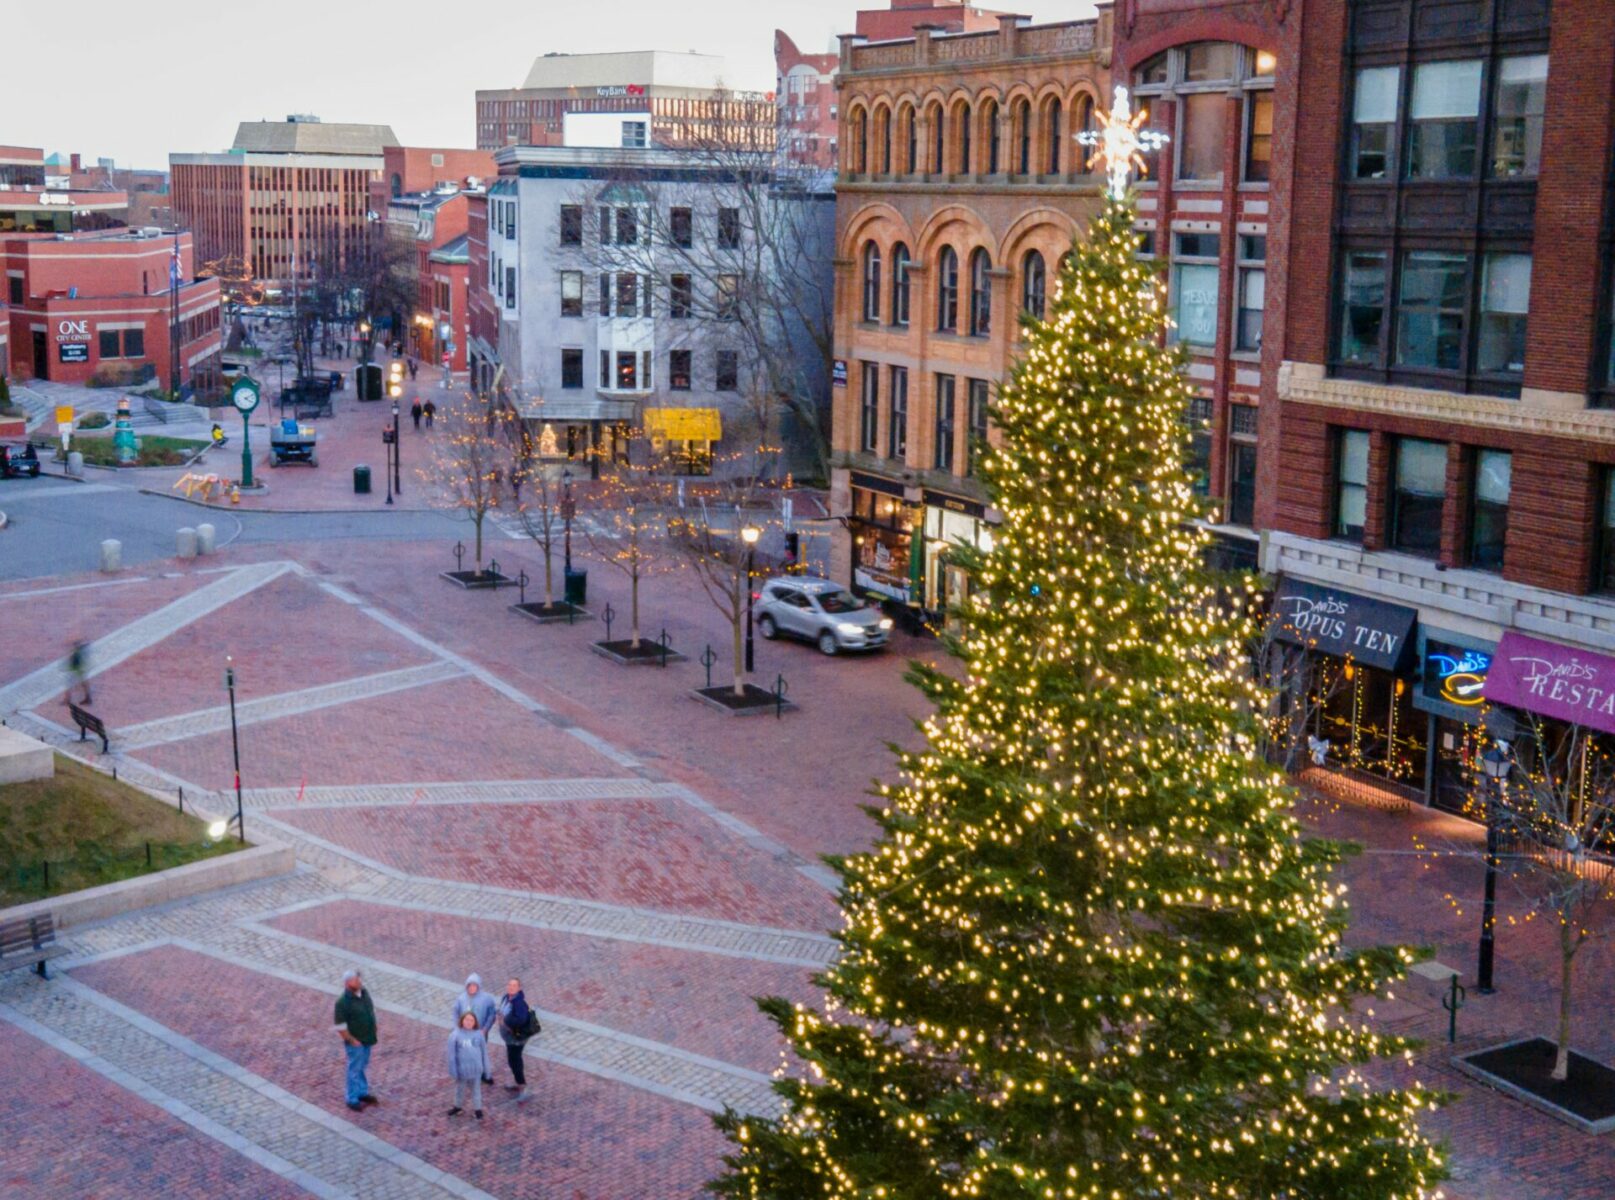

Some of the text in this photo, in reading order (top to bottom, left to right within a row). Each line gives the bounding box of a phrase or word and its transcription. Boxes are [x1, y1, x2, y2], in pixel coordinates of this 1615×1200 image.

[597, 86, 627, 97] KeyBank
[59, 320, 88, 334] ONE
[1294, 611, 1398, 654] OPUS TEN
[1529, 674, 1615, 714] RESTA
